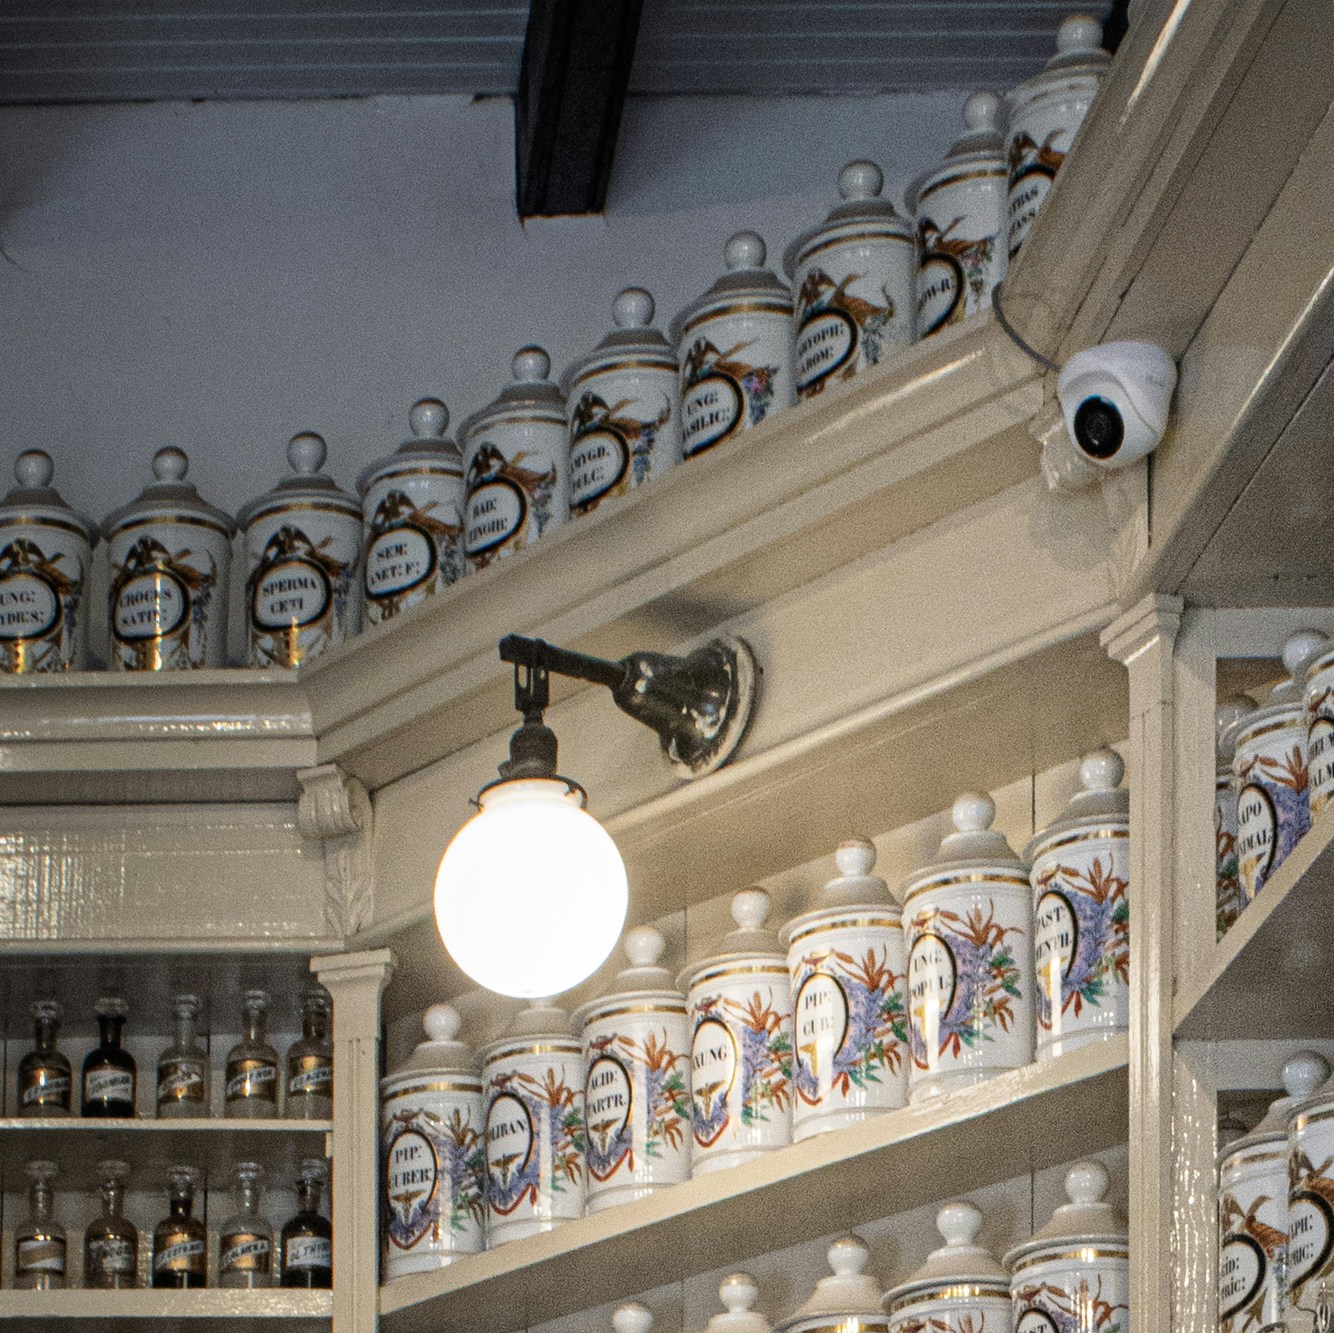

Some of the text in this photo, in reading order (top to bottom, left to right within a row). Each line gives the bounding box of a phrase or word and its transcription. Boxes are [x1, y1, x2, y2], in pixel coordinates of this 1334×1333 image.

[262, 577, 317, 598] SPERMA
[269, 599, 305, 616] CETI
[804, 990, 832, 1011] PIP:
[395, 1144, 422, 1165] PIP:
